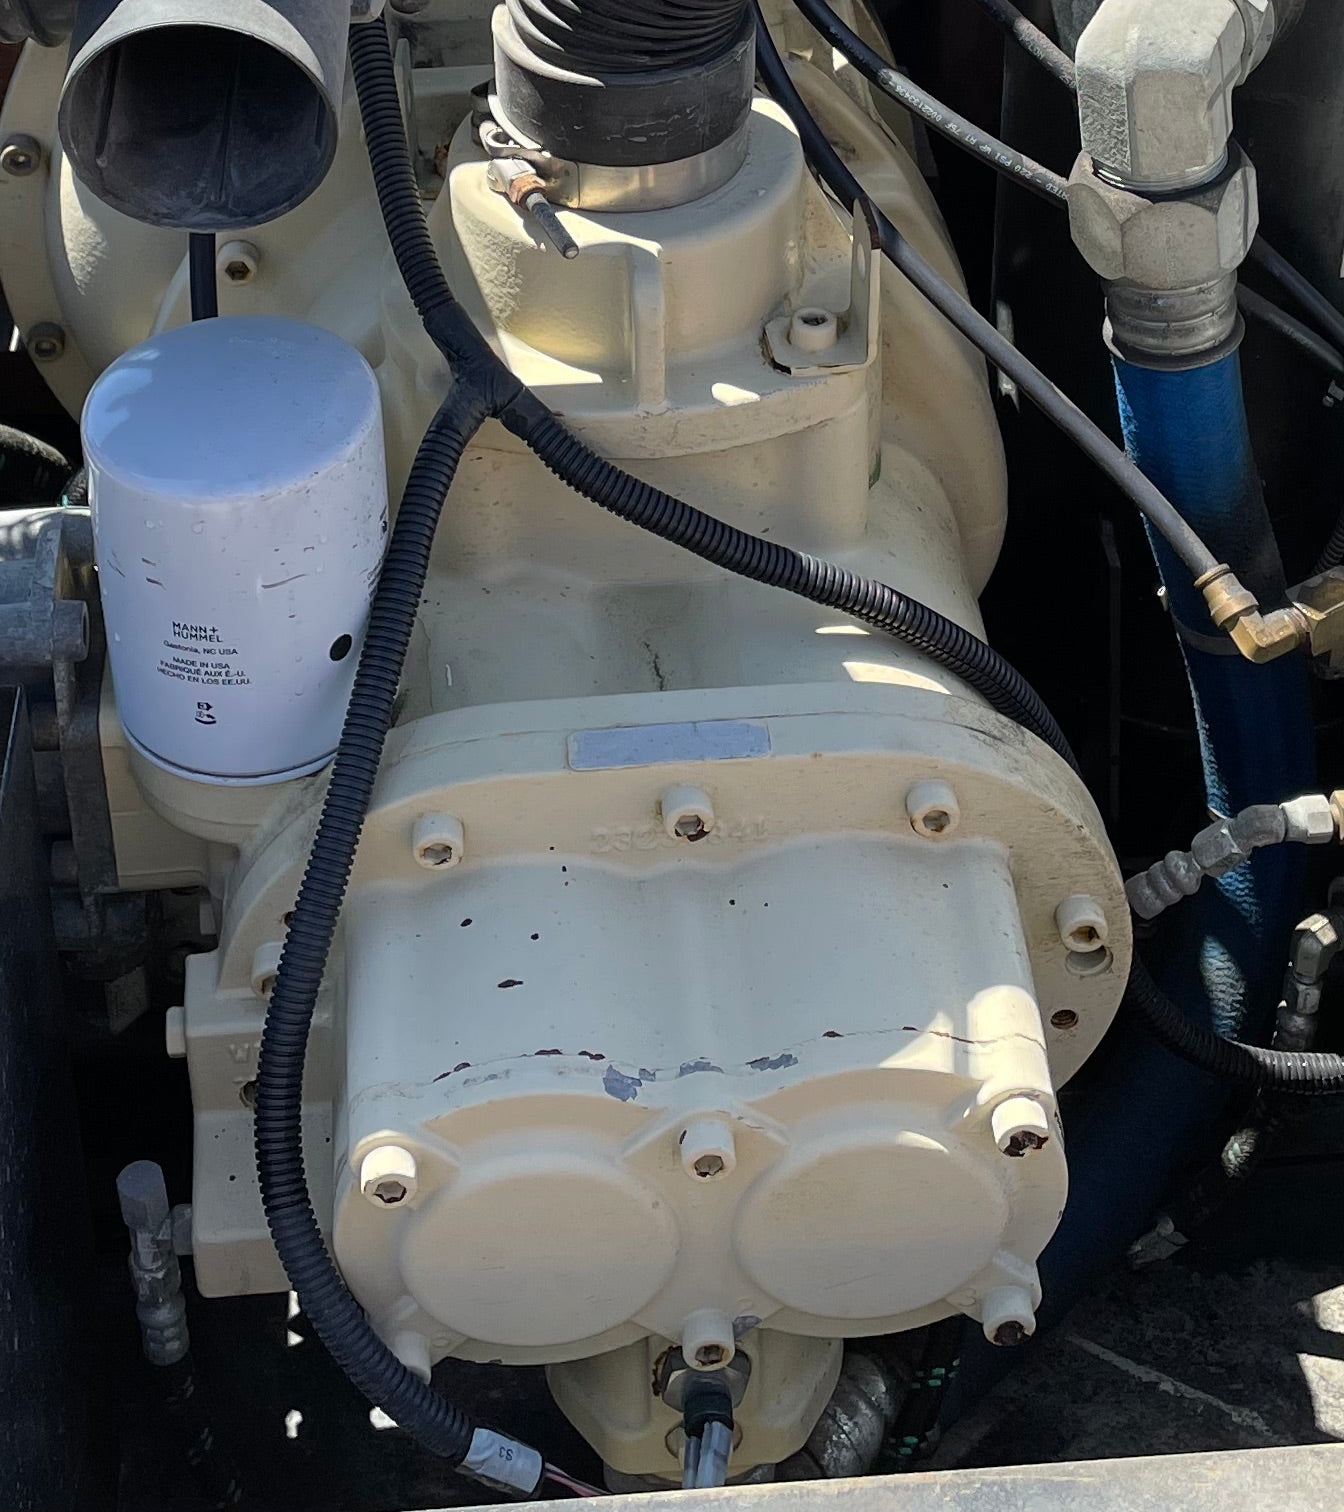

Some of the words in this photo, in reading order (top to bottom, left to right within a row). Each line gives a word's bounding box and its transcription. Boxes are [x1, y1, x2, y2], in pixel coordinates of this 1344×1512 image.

[173, 630, 224, 643] HUMMEL
[202, 647, 217, 656] NC
[218, 648, 239, 656] USA
[172, 656, 197, 668] MADE
[199, 661, 209, 669] IN
[210, 662, 231, 670] USA
[203, 669, 223, 678] AUX
[187, 675, 199, 683] EN
[201, 677, 220, 686] LOS
[498, 1445, 514, 1462] S3
